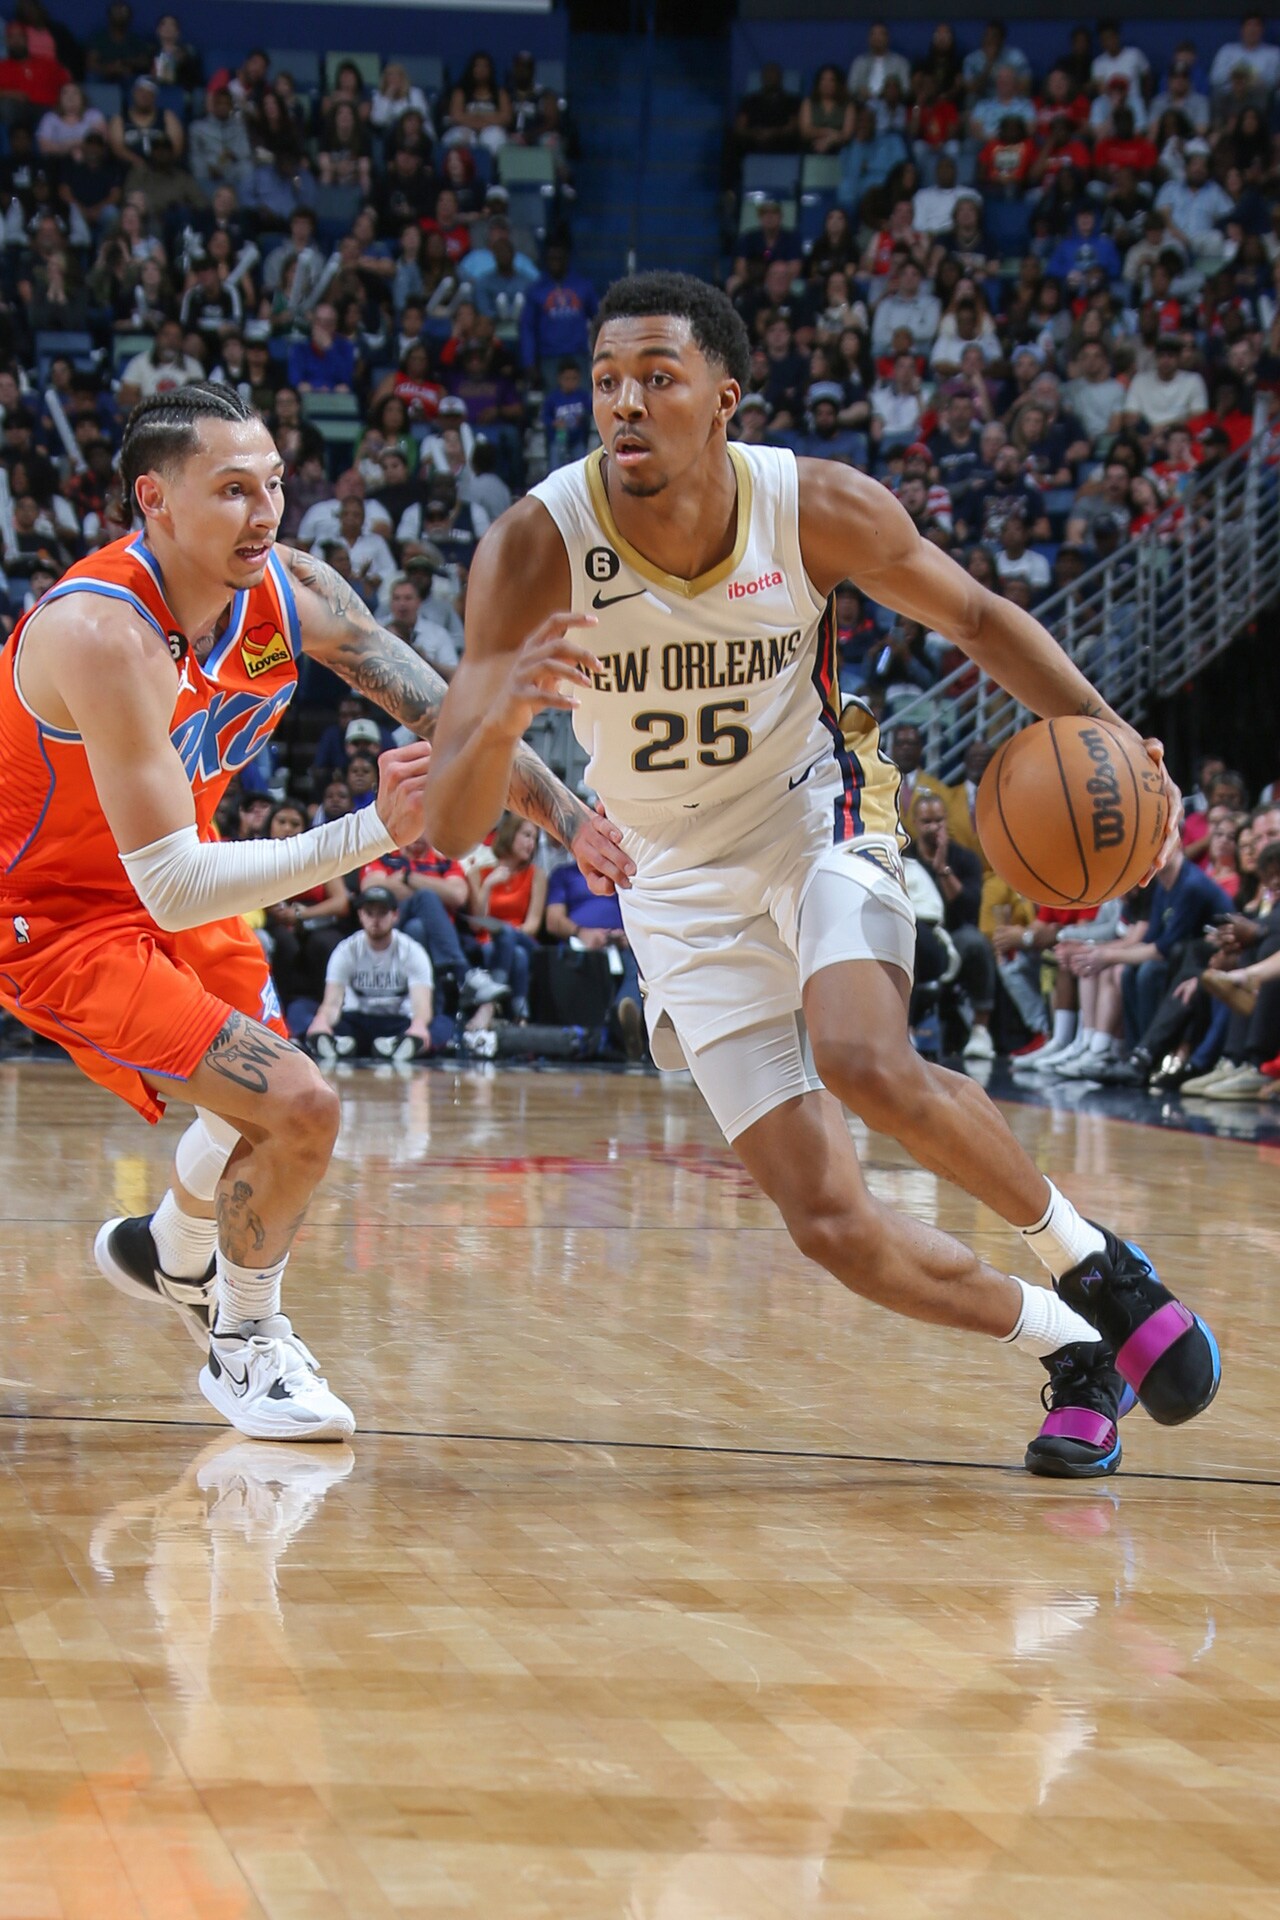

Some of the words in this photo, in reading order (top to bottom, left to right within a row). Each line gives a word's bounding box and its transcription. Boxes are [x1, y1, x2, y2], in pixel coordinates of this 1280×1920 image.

[593, 551, 612, 578] 6
[727, 570, 783, 600] ibotta
[661, 629, 802, 691] ORLEANS
[631, 698, 752, 772] 25
[1078, 727, 1125, 852] Wilson
